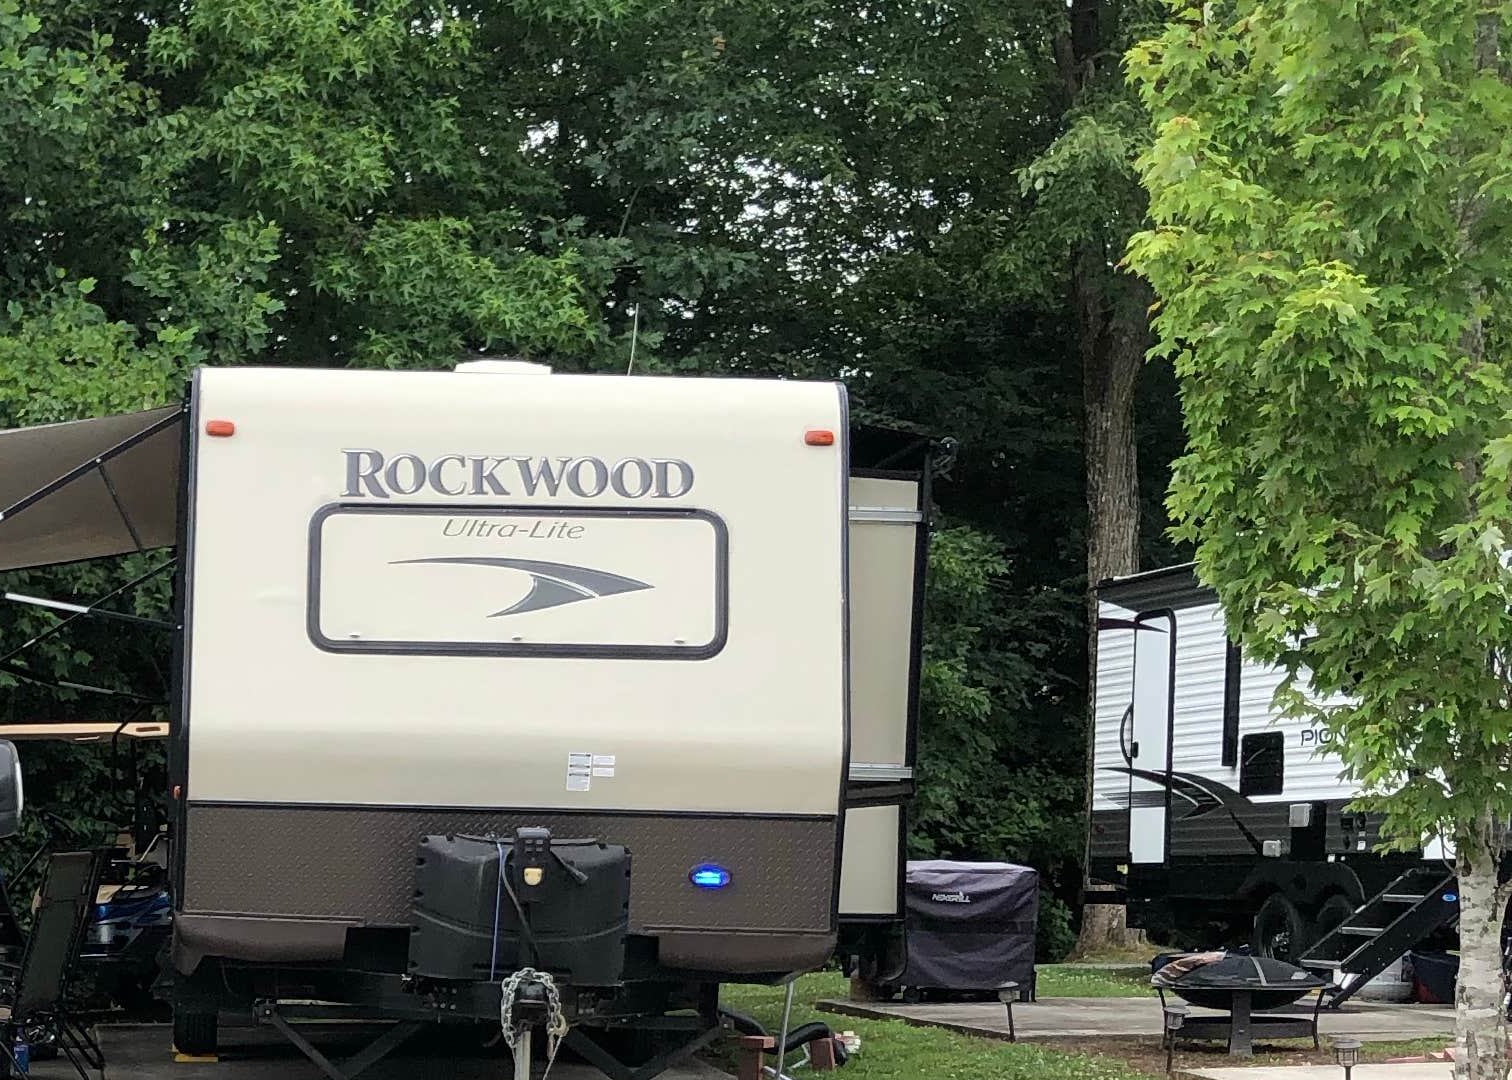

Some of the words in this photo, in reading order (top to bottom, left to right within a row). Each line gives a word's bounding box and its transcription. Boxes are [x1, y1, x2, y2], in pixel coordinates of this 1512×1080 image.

[339, 447, 695, 499] ROCKWOOD
[442, 518, 585, 540] Ultra-Lite
[1300, 727, 1347, 747] PION
